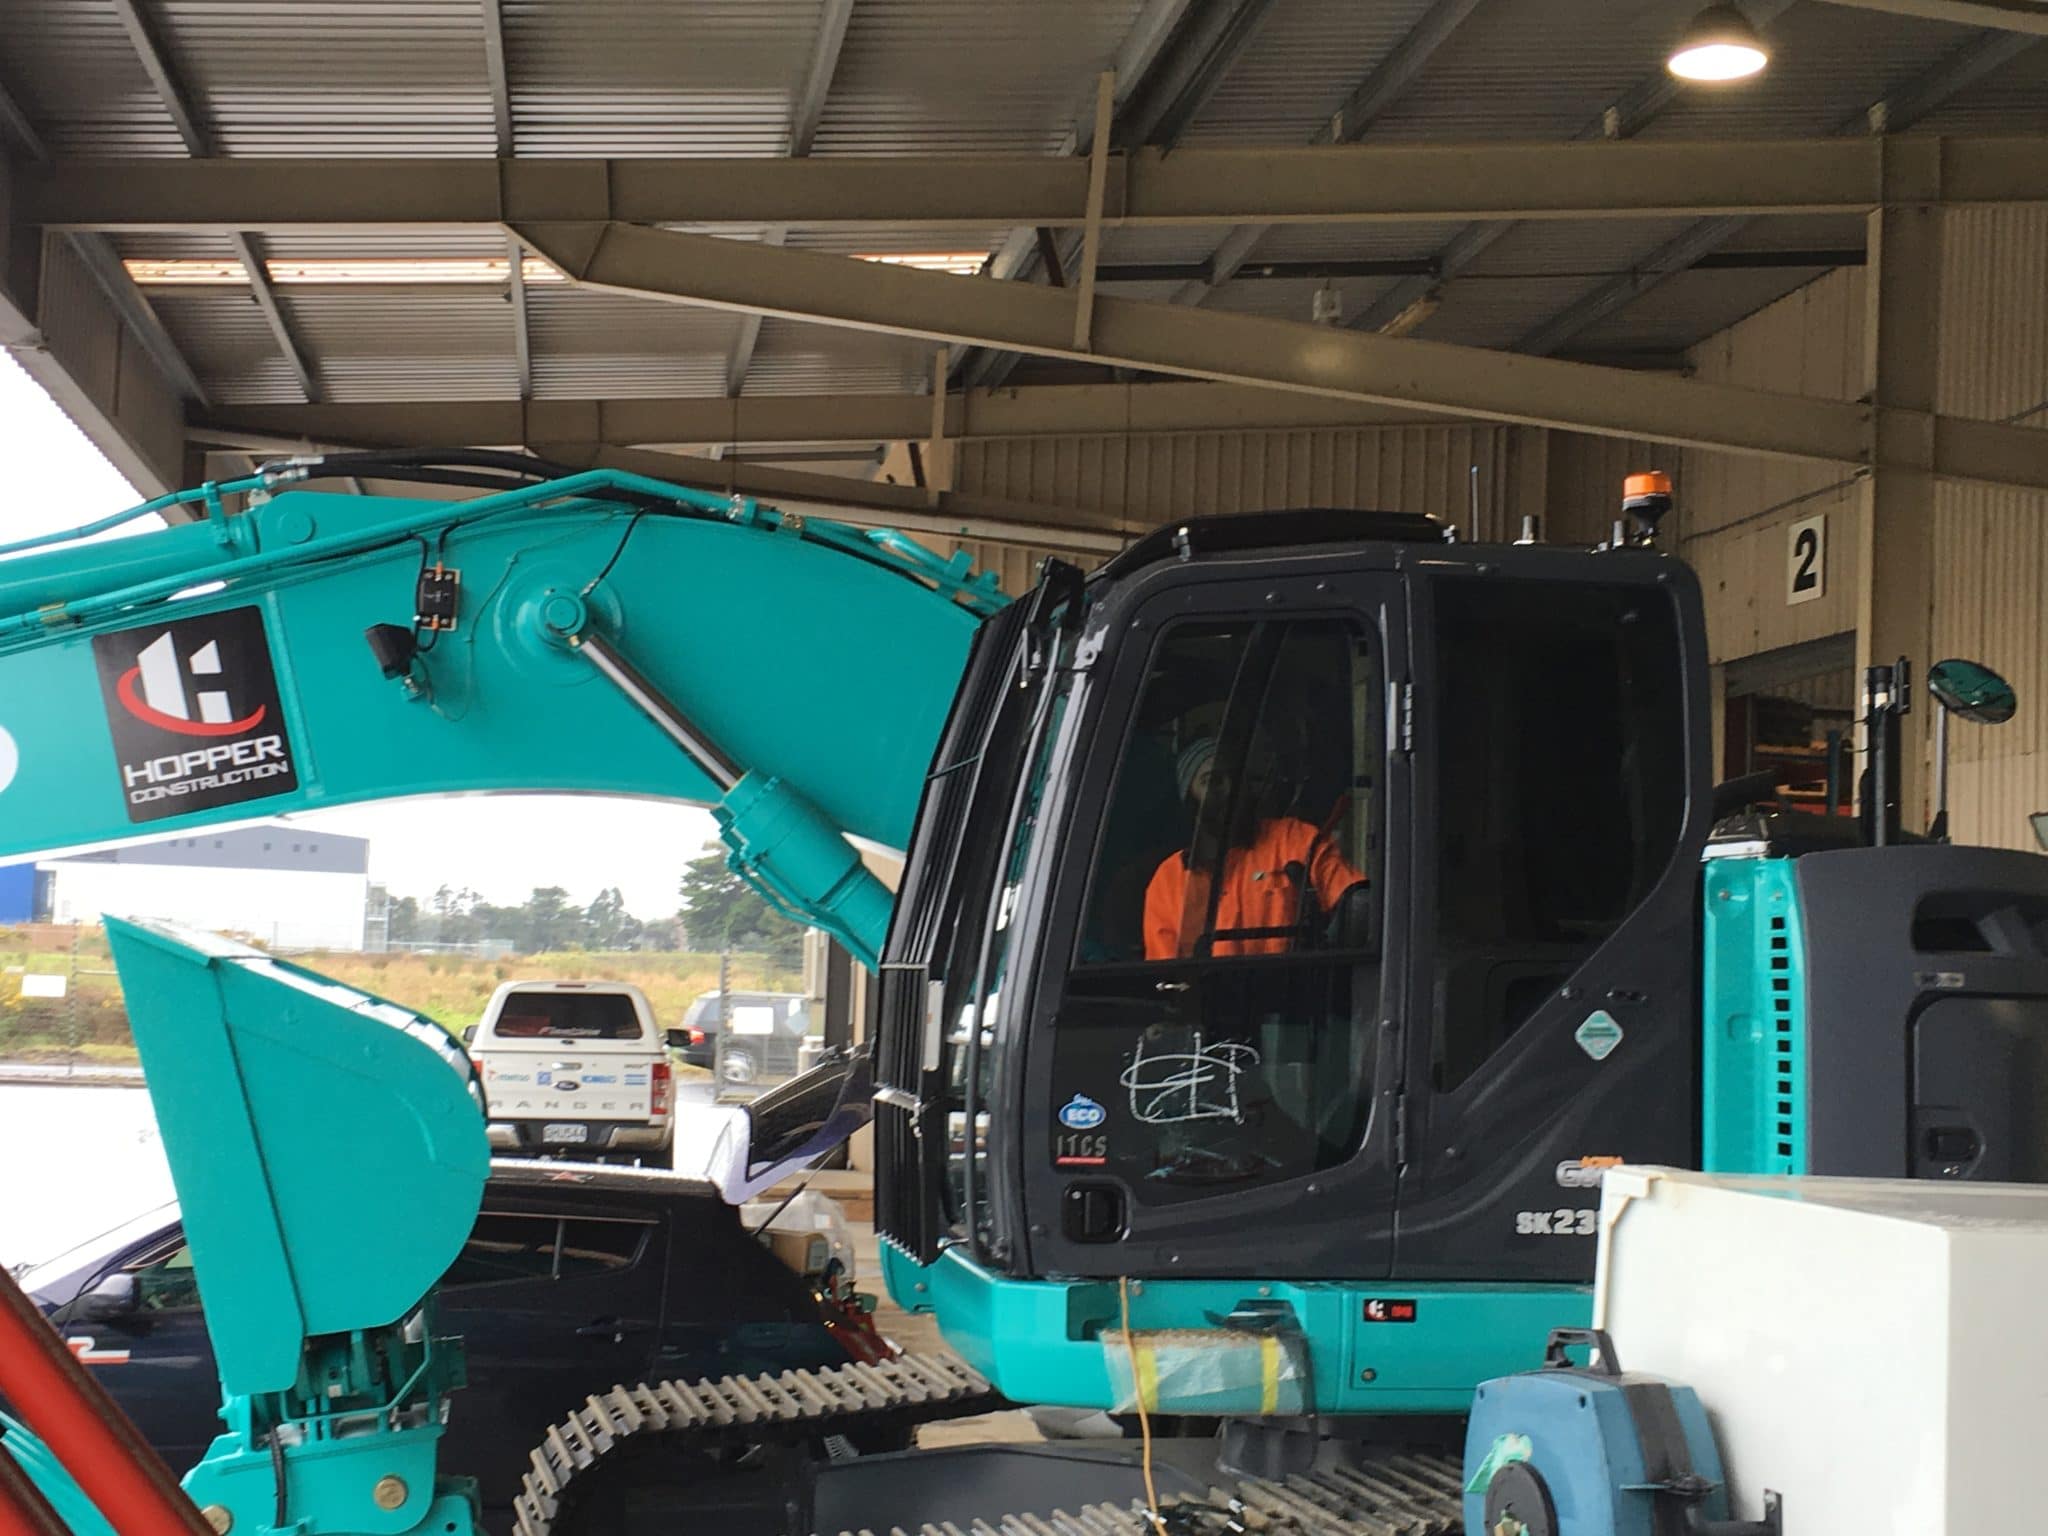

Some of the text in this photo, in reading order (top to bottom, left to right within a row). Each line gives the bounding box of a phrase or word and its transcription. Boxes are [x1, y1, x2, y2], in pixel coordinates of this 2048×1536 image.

[1793, 528, 1817, 593] 2
[123, 735, 285, 787] HOPPER
[130, 761, 289, 804] CONSTRUCTION
[487, 1100, 645, 1111] RANGER
[1516, 1209, 1600, 1235] SK23
